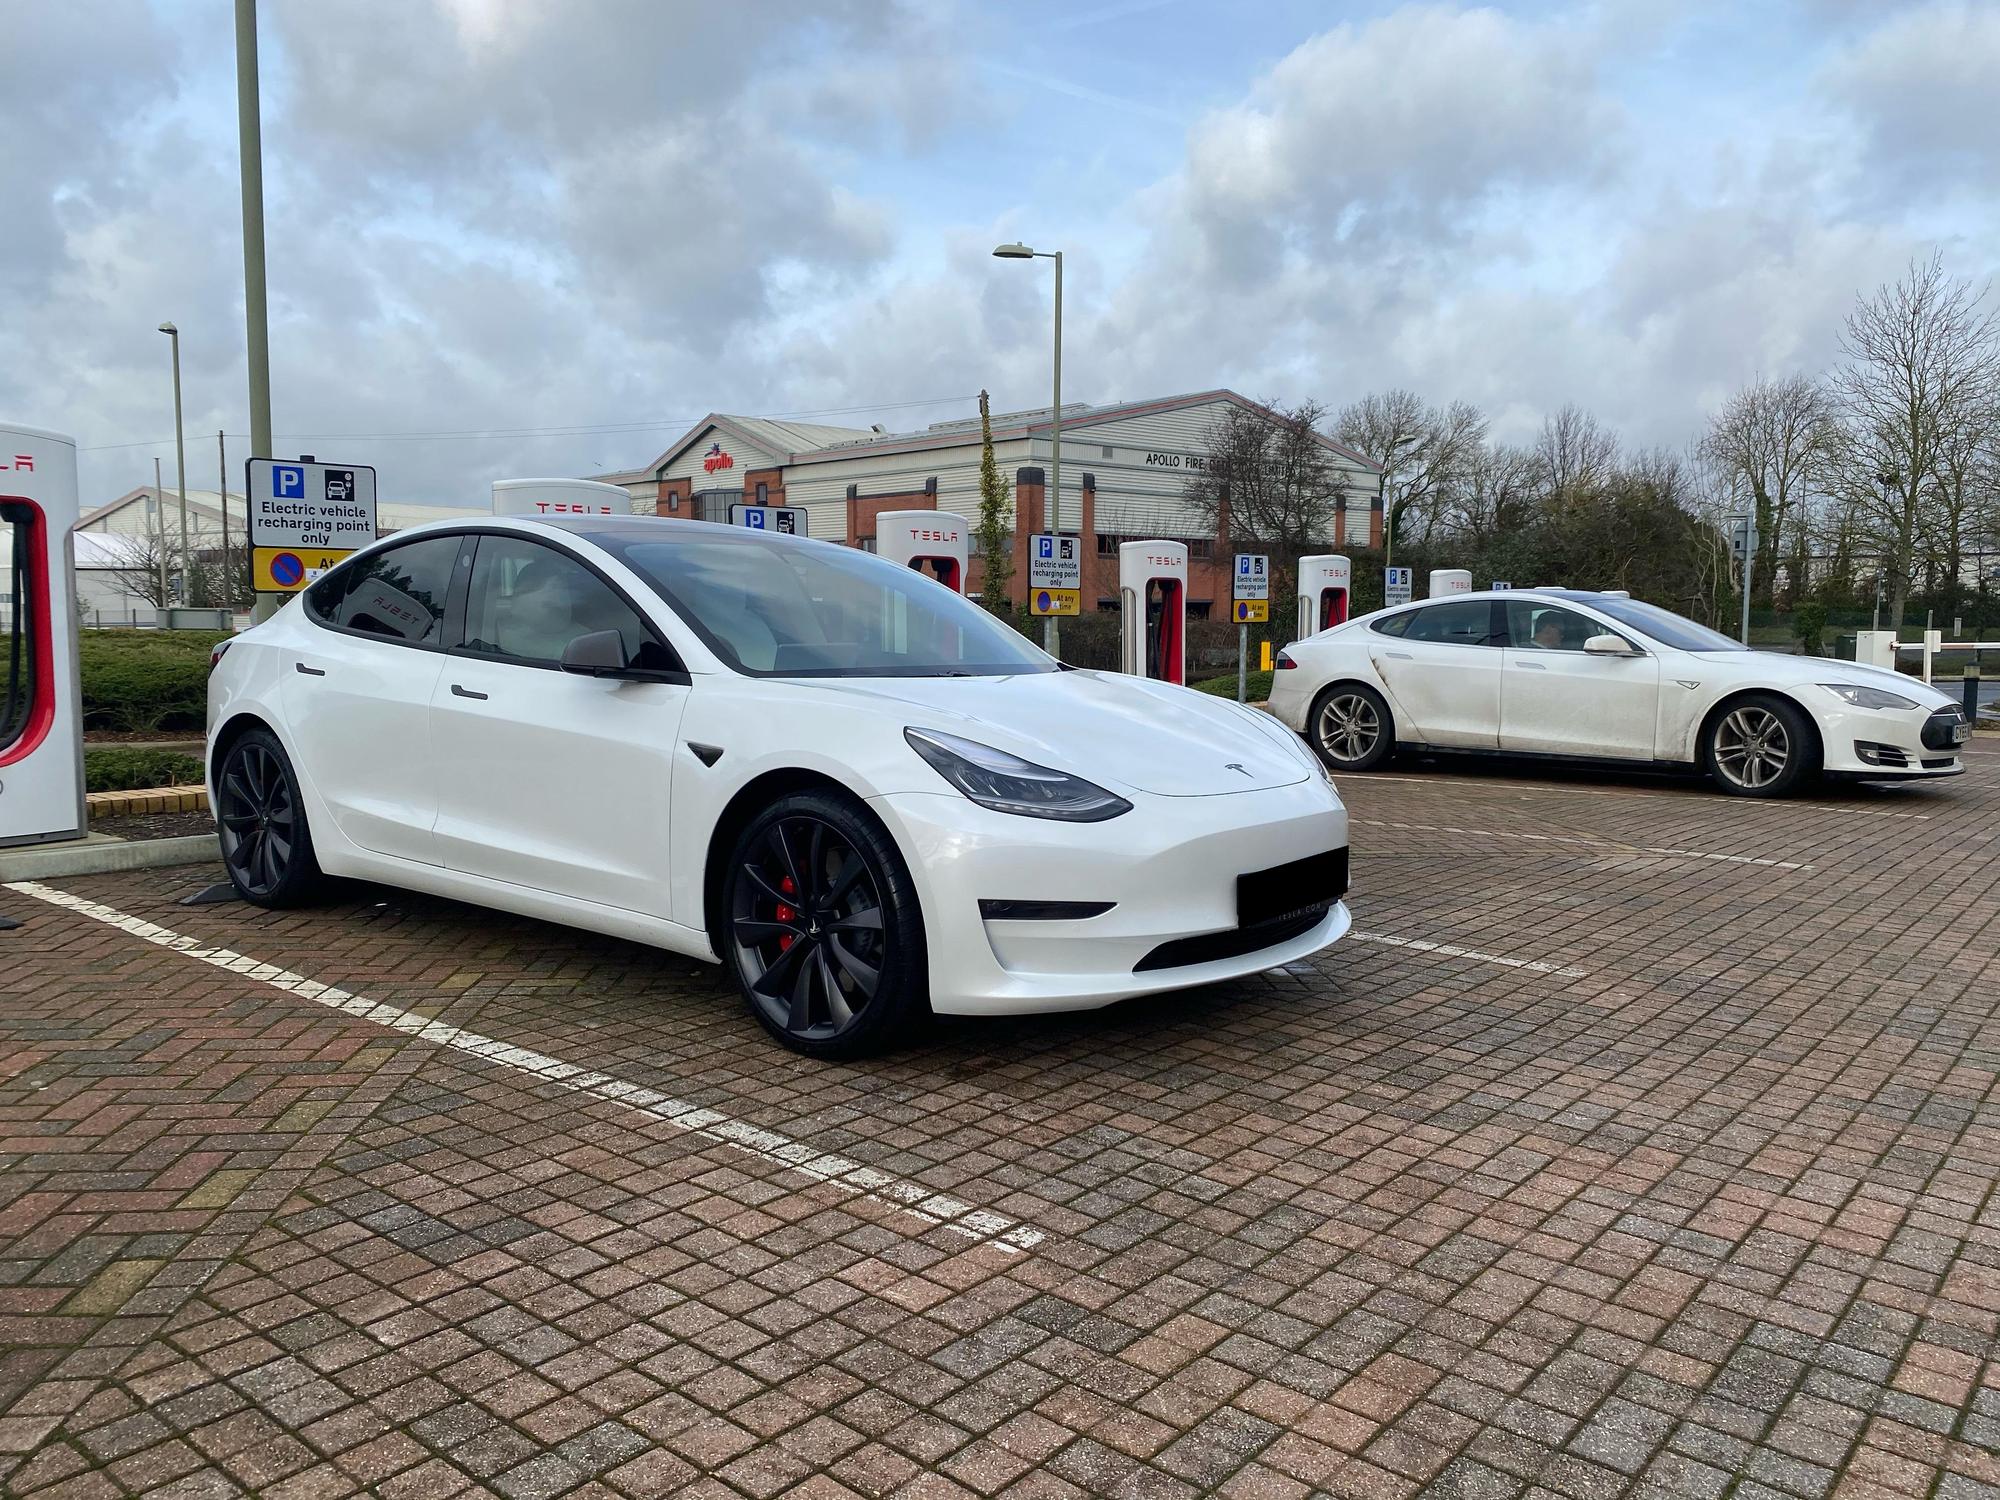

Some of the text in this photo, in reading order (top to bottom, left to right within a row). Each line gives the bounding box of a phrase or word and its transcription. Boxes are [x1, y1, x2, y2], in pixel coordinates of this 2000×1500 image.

[1145, 453, 1180, 467] APOLLO
[1185, 456, 1206, 469] FIRE
[280, 469, 299, 495] P
[261, 501, 366, 518] Electric vehicle
[258, 517, 370, 532] recharging point
[750, 512, 762, 528] P
[301, 532, 330, 546] only
[910, 529, 958, 542] TESLA
[1042, 541, 1050, 556] P
[1034, 560, 1077, 569] Electric vehicle
[1147, 556, 1181, 565] TESLA
[1032, 569, 1079, 578] recharging point
[1322, 569, 1348, 577] TESLA
[1050, 579, 1062, 587] only
